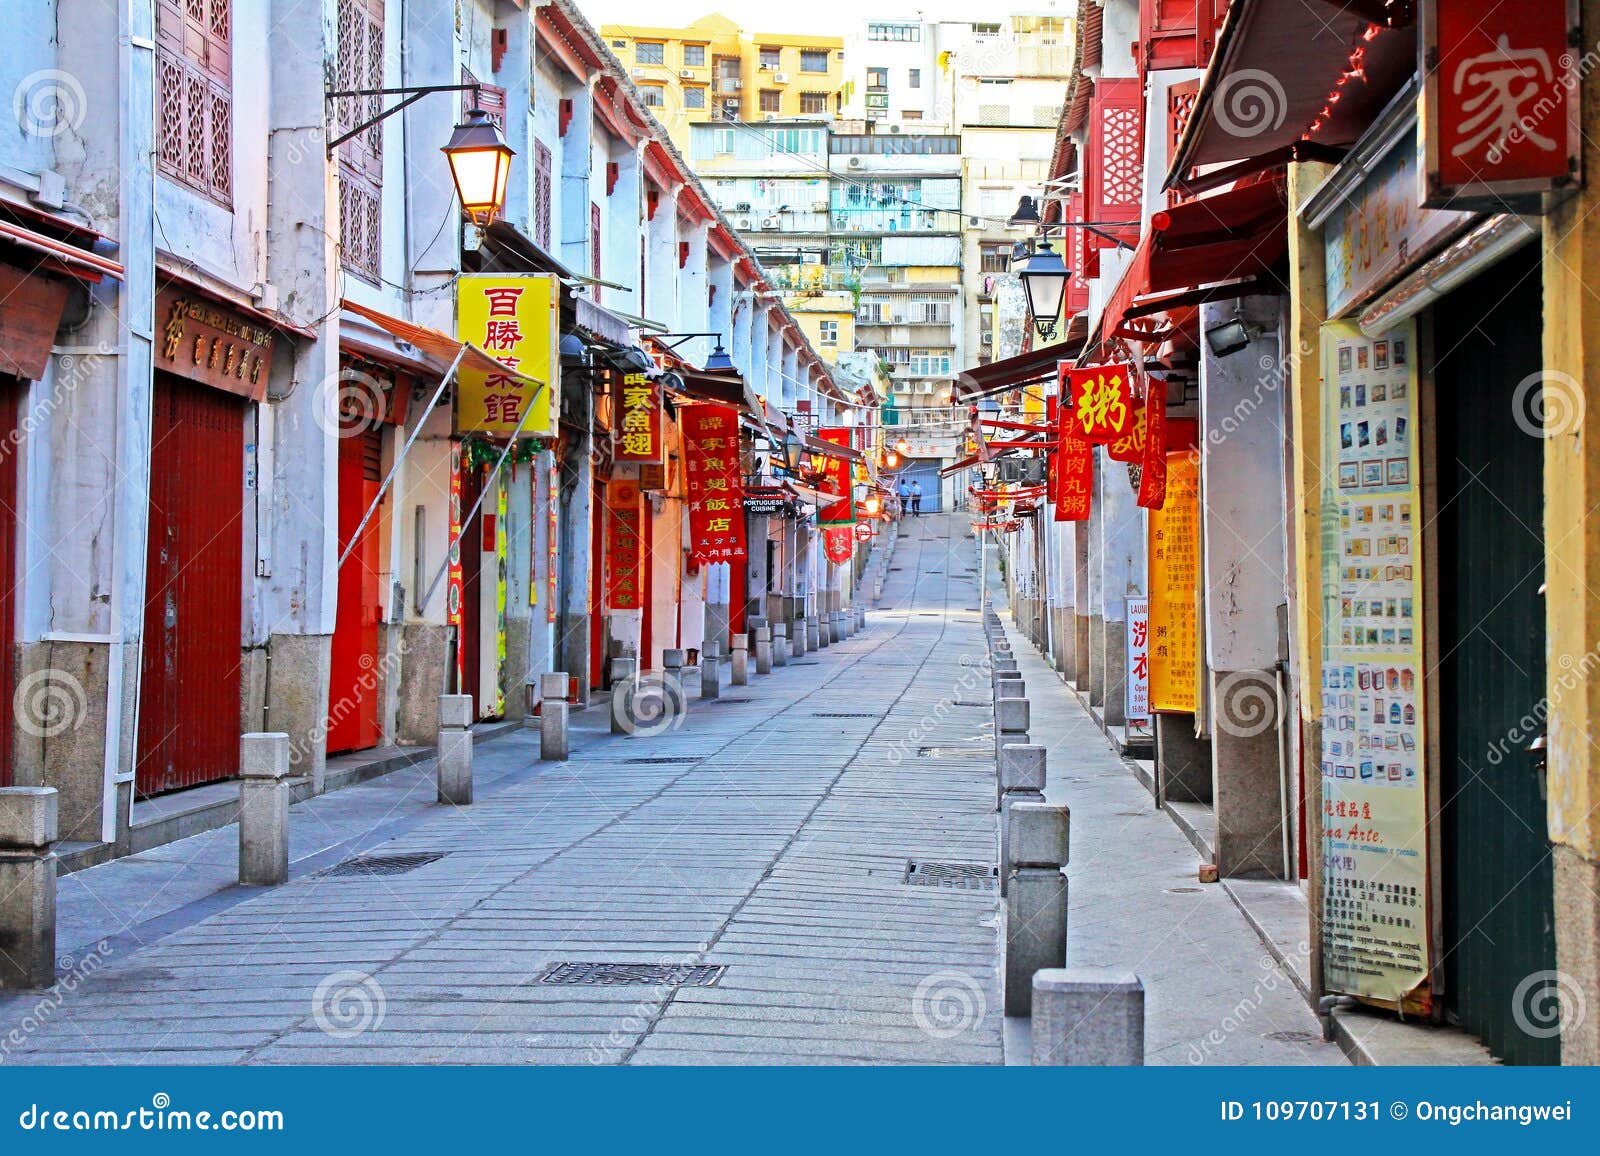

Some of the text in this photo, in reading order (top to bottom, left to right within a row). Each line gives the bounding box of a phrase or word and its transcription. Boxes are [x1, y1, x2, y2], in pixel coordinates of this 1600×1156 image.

[1077, 374, 1127, 434] 粥
[698, 416, 732, 532] 譚家魚翅飯店
[1321, 824, 1342, 838] ina
